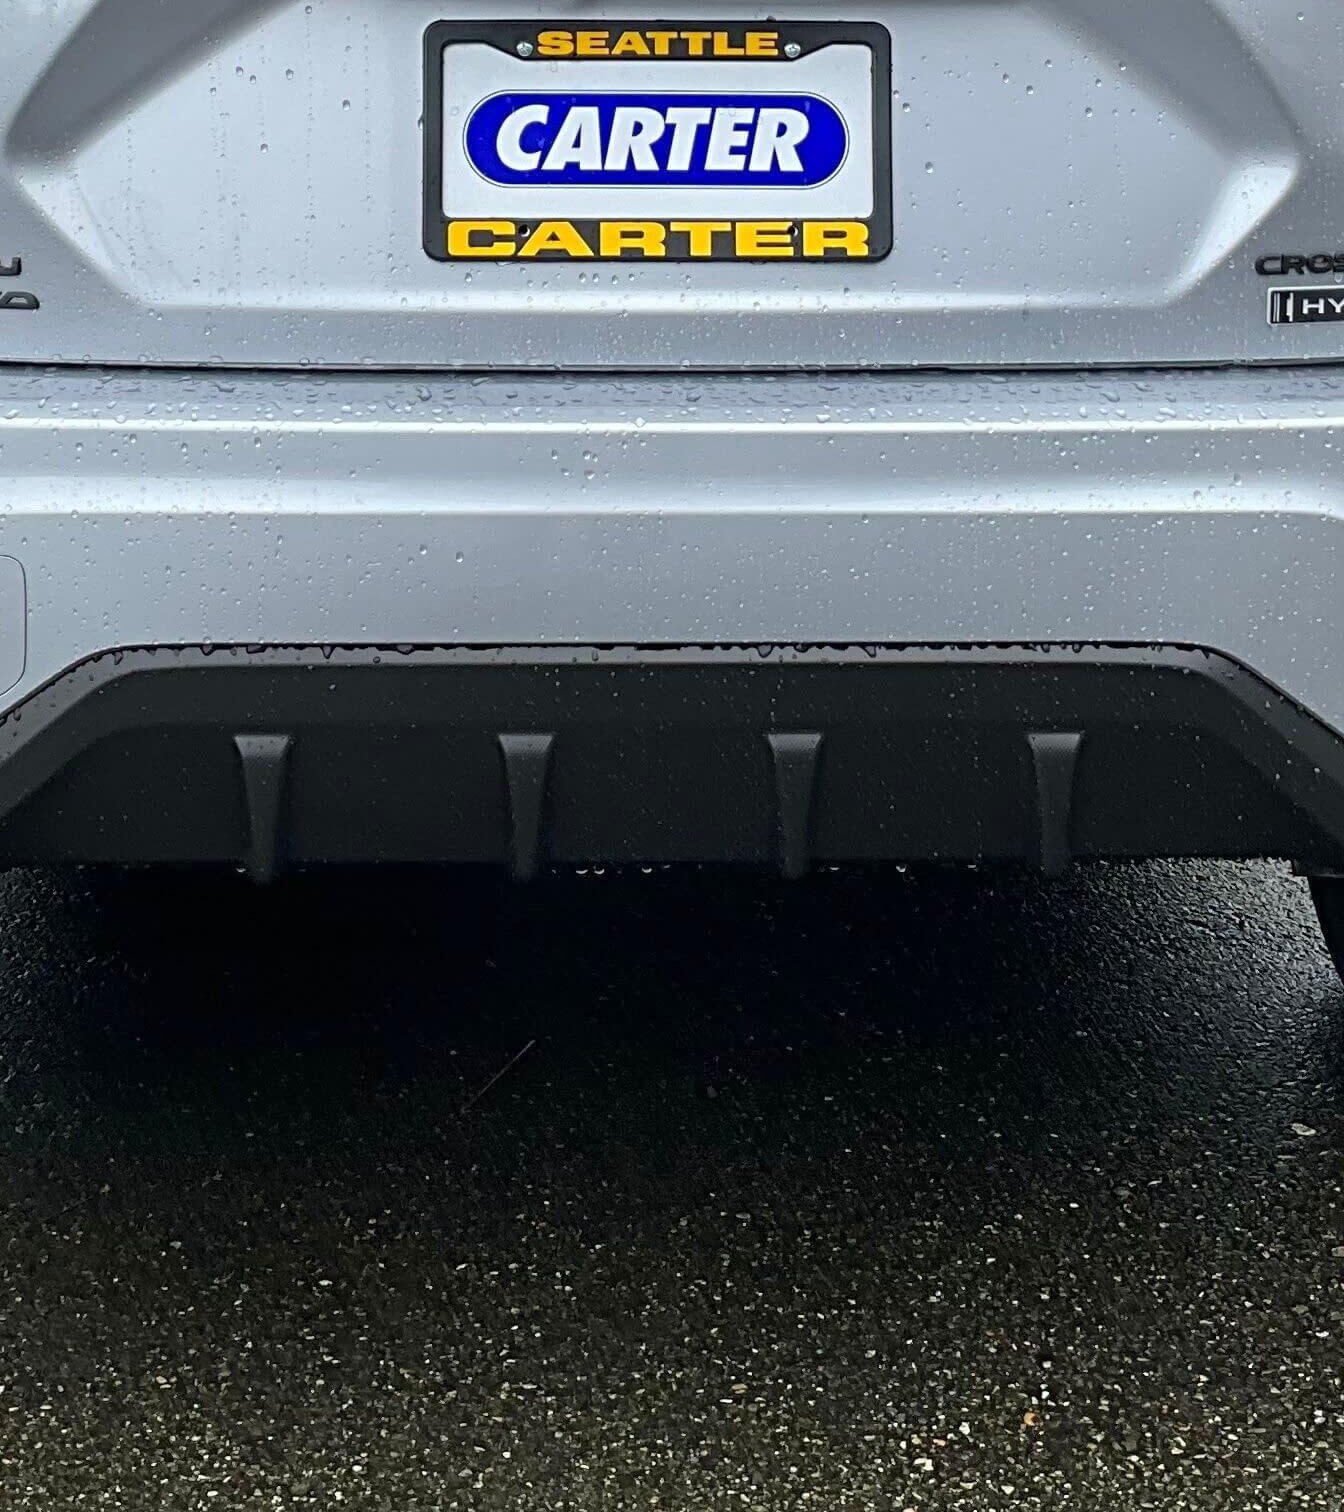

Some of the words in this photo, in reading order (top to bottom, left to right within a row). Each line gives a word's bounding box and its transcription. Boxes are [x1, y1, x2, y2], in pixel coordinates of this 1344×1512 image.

[537, 31, 779, 56] SEATTLE
[496, 104, 810, 172] CARTER
[447, 221, 869, 256] CARTER
